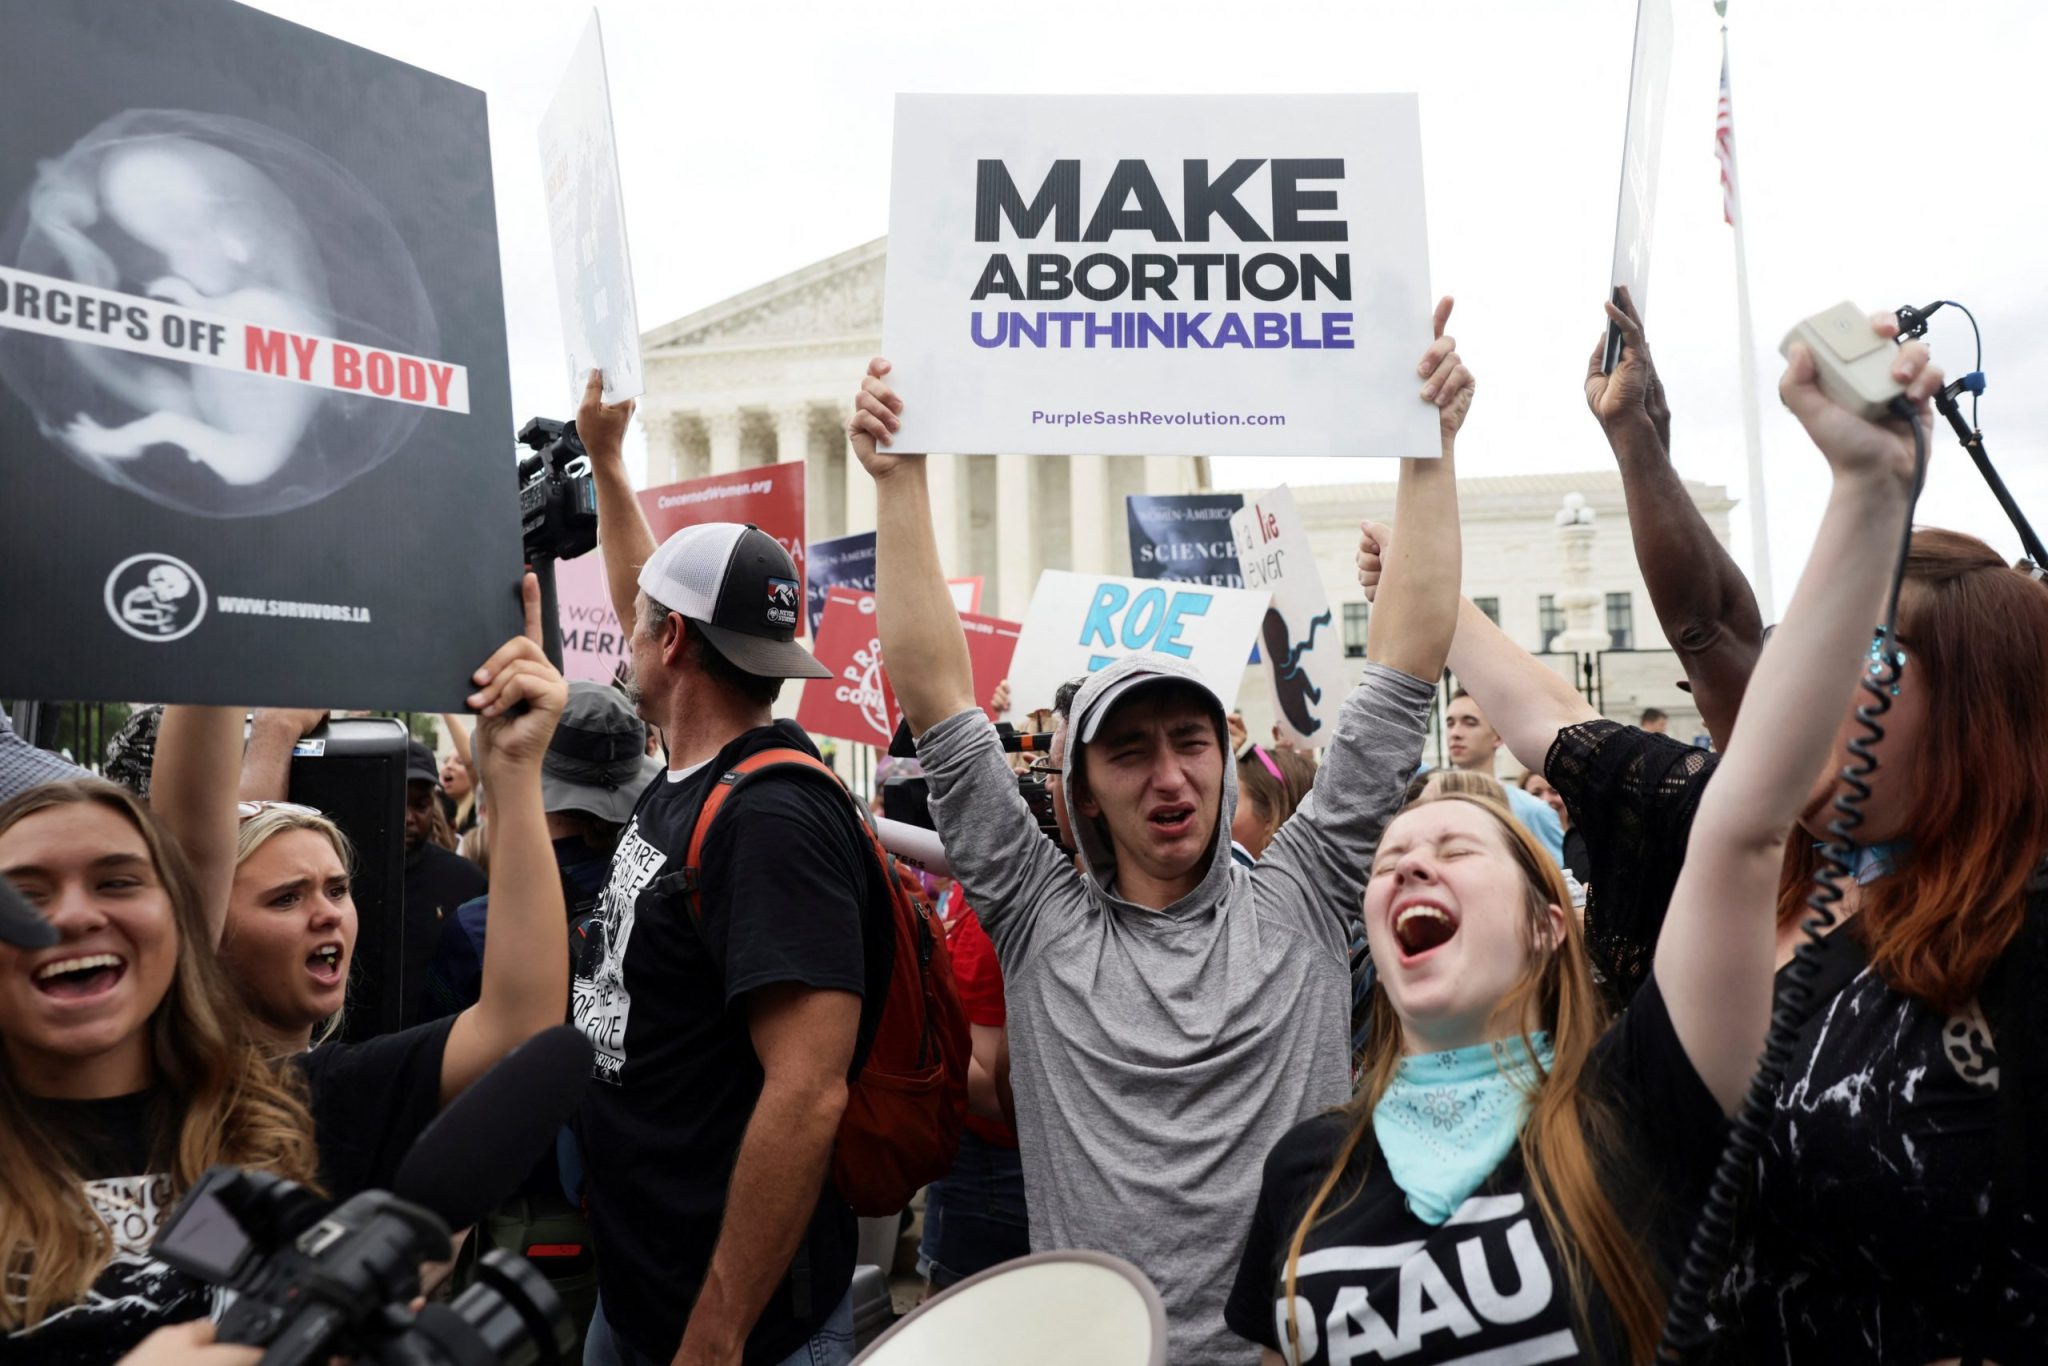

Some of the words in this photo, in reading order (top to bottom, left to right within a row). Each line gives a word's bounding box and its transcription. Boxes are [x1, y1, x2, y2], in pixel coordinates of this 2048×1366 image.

[974, 157, 1349, 243] MAKE
[969, 252, 1352, 301] ABORTION
[969, 311, 1355, 349] UNTHINKABLE
[162, 314, 226, 356] OFF
[245, 324, 319, 382] MY
[332, 343, 454, 408] BODY
[1031, 410, 1286, 427] PurpleSashRevolution.com
[657, 479, 773, 509] ConcernedWomen.org
[1255, 504, 1279, 545] lie
[217, 595, 371, 623] WWW.SURVIVORS.LA
[1078, 583, 1214, 659] ROE
[1275, 1218, 1554, 1366] PAAU
